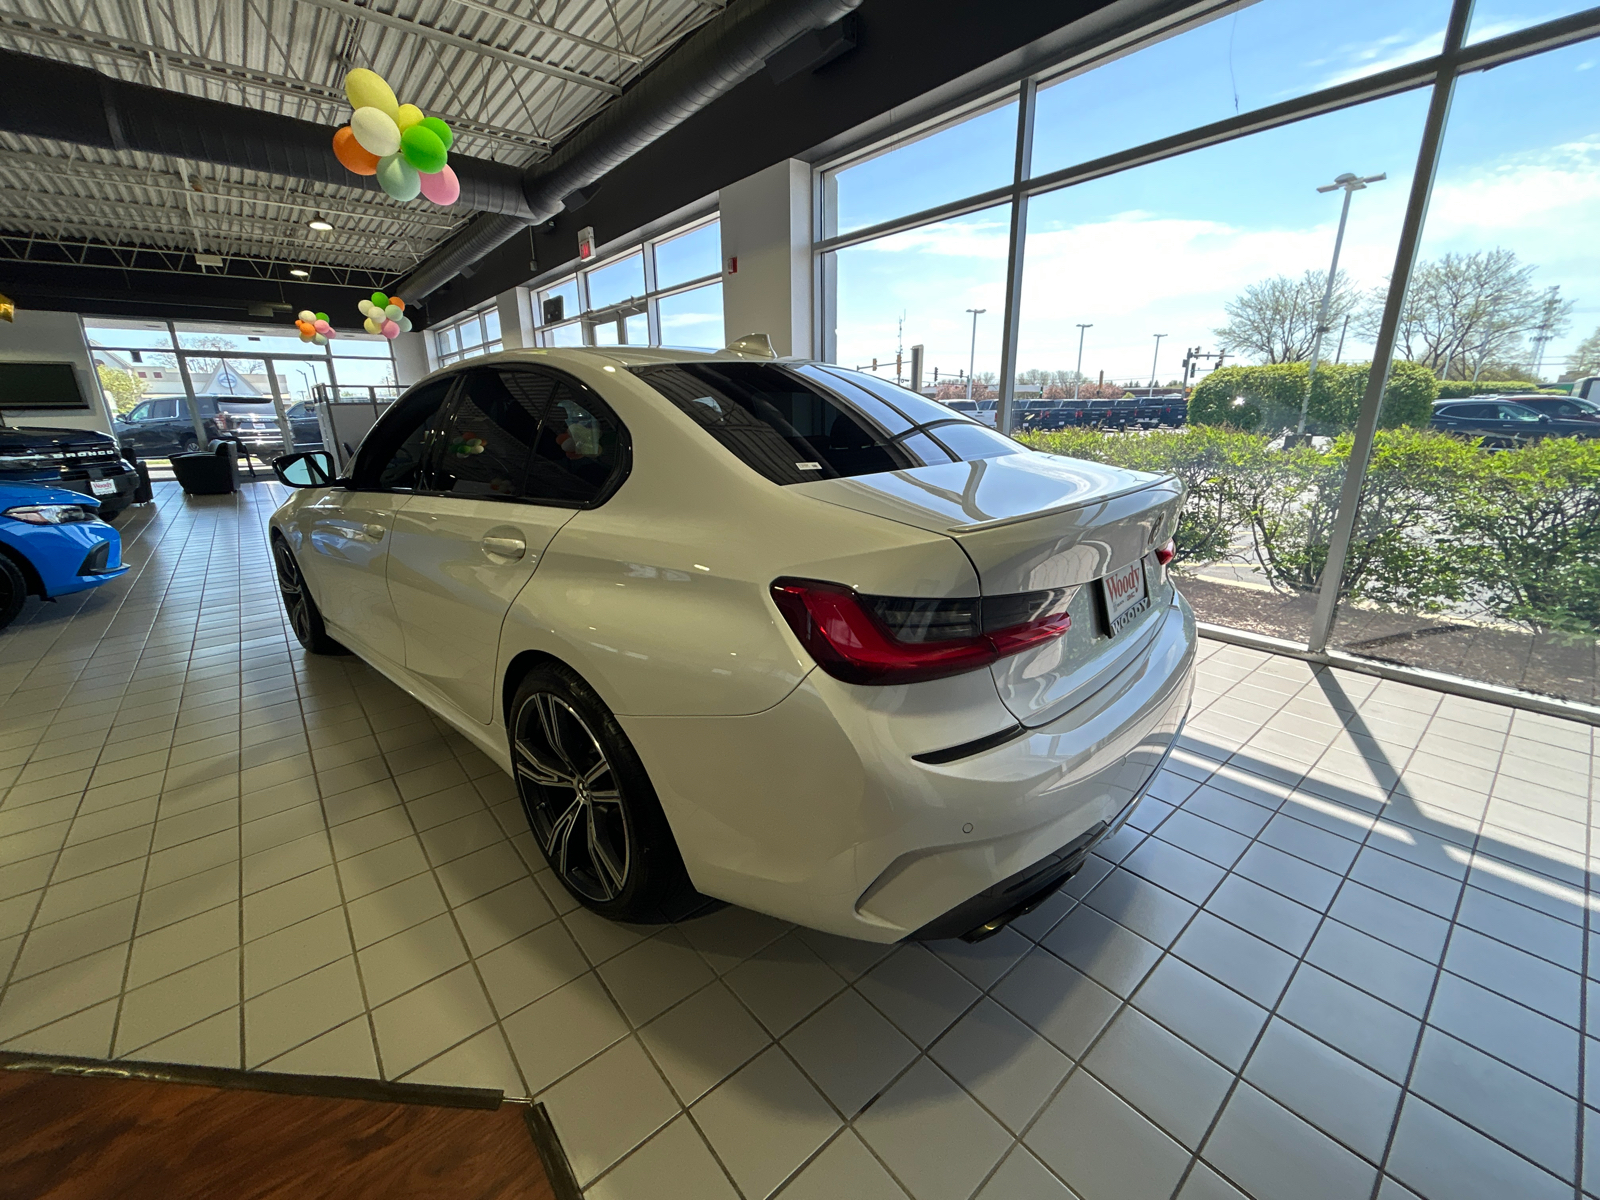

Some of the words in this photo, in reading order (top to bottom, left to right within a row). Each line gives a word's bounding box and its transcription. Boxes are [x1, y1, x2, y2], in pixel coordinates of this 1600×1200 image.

[53, 450, 114, 459] BRONCO
[1106, 565, 1140, 602] Woody
[1112, 597, 1148, 635] WOODY
